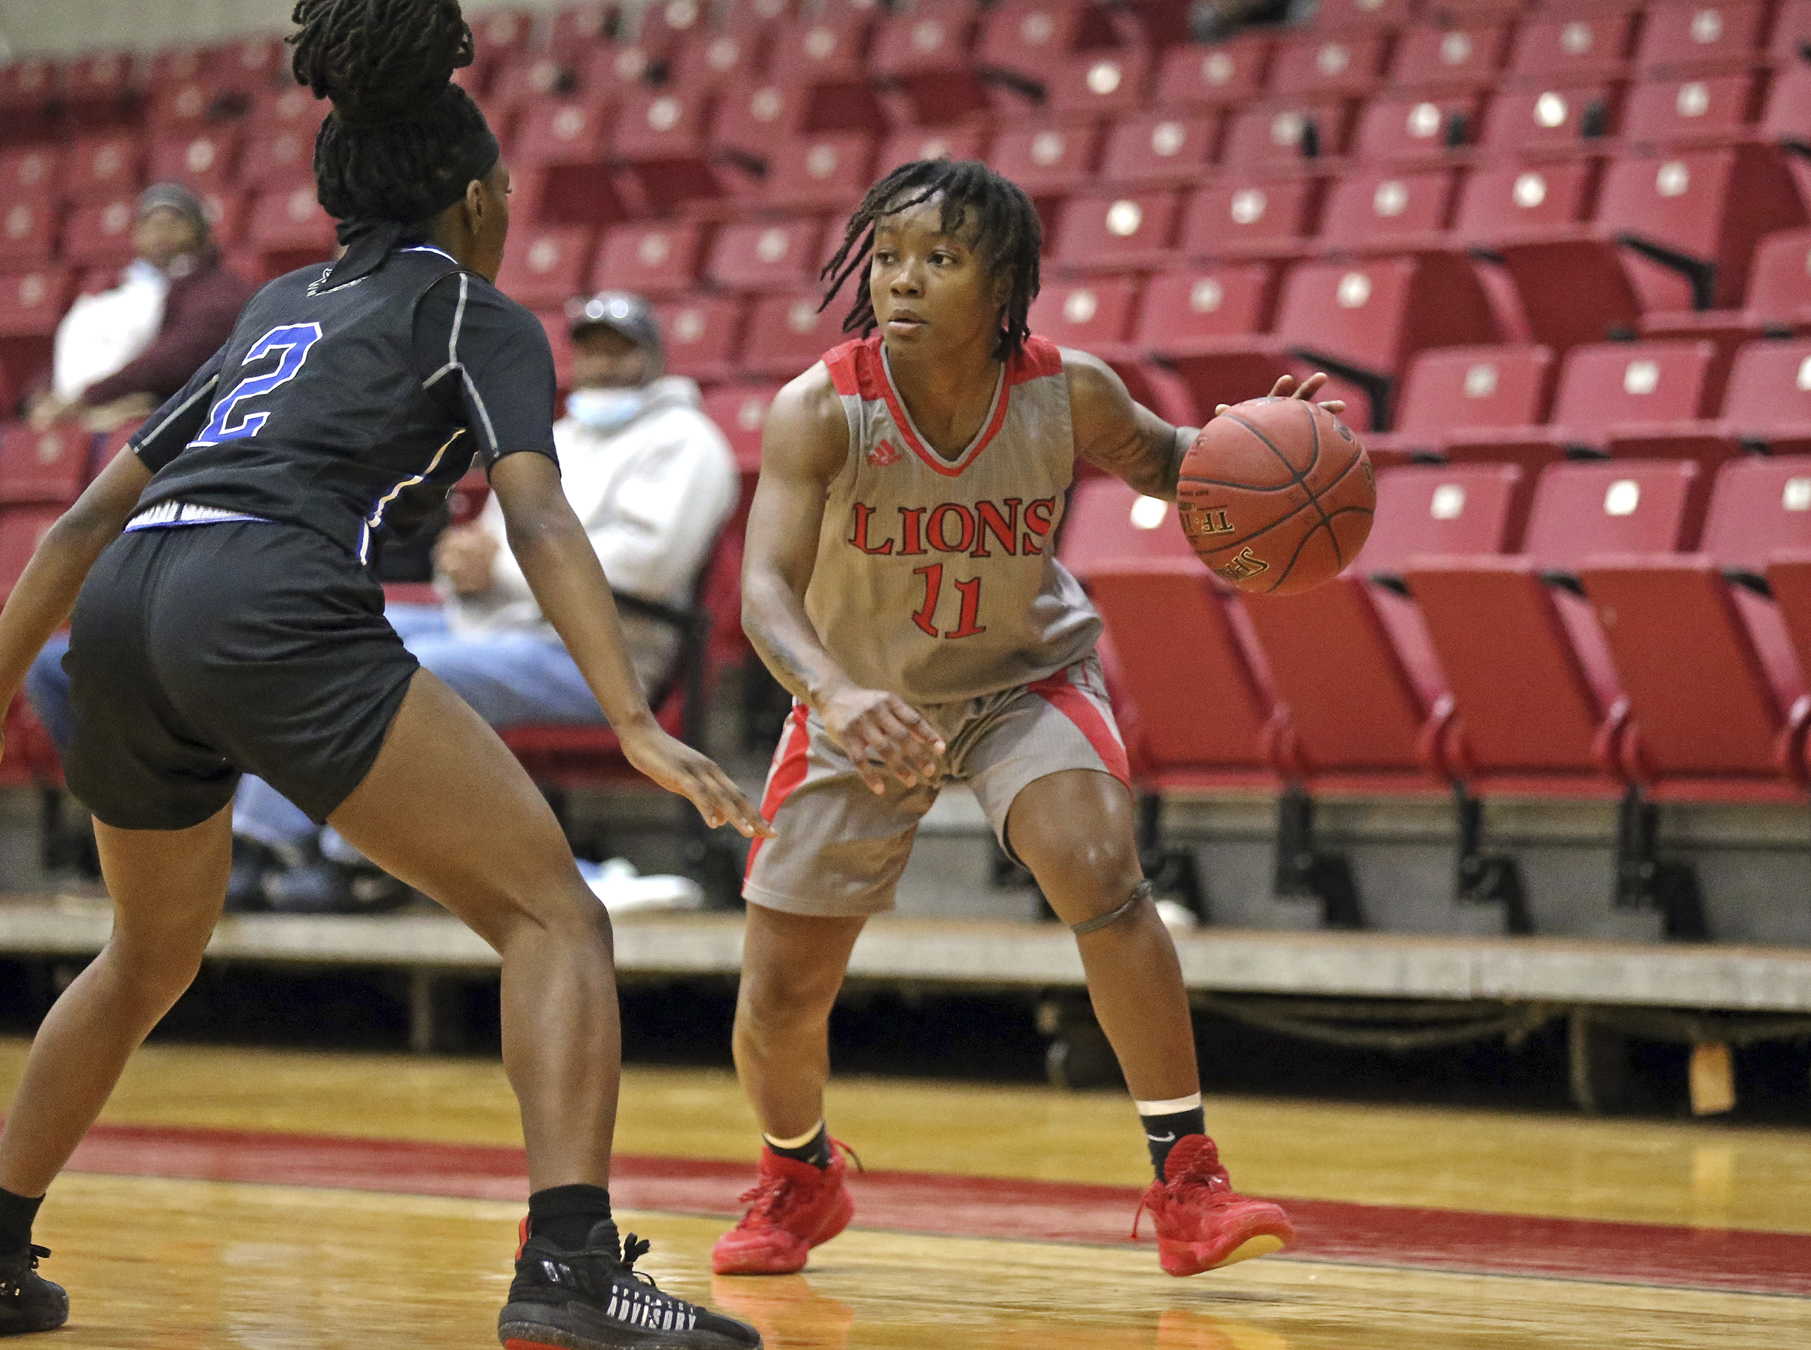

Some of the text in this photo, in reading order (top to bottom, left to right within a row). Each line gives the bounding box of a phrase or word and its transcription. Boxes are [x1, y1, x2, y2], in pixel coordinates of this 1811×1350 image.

[186, 321, 323, 450] 2
[848, 496, 1056, 558] LIONS
[911, 563, 987, 639] 11
